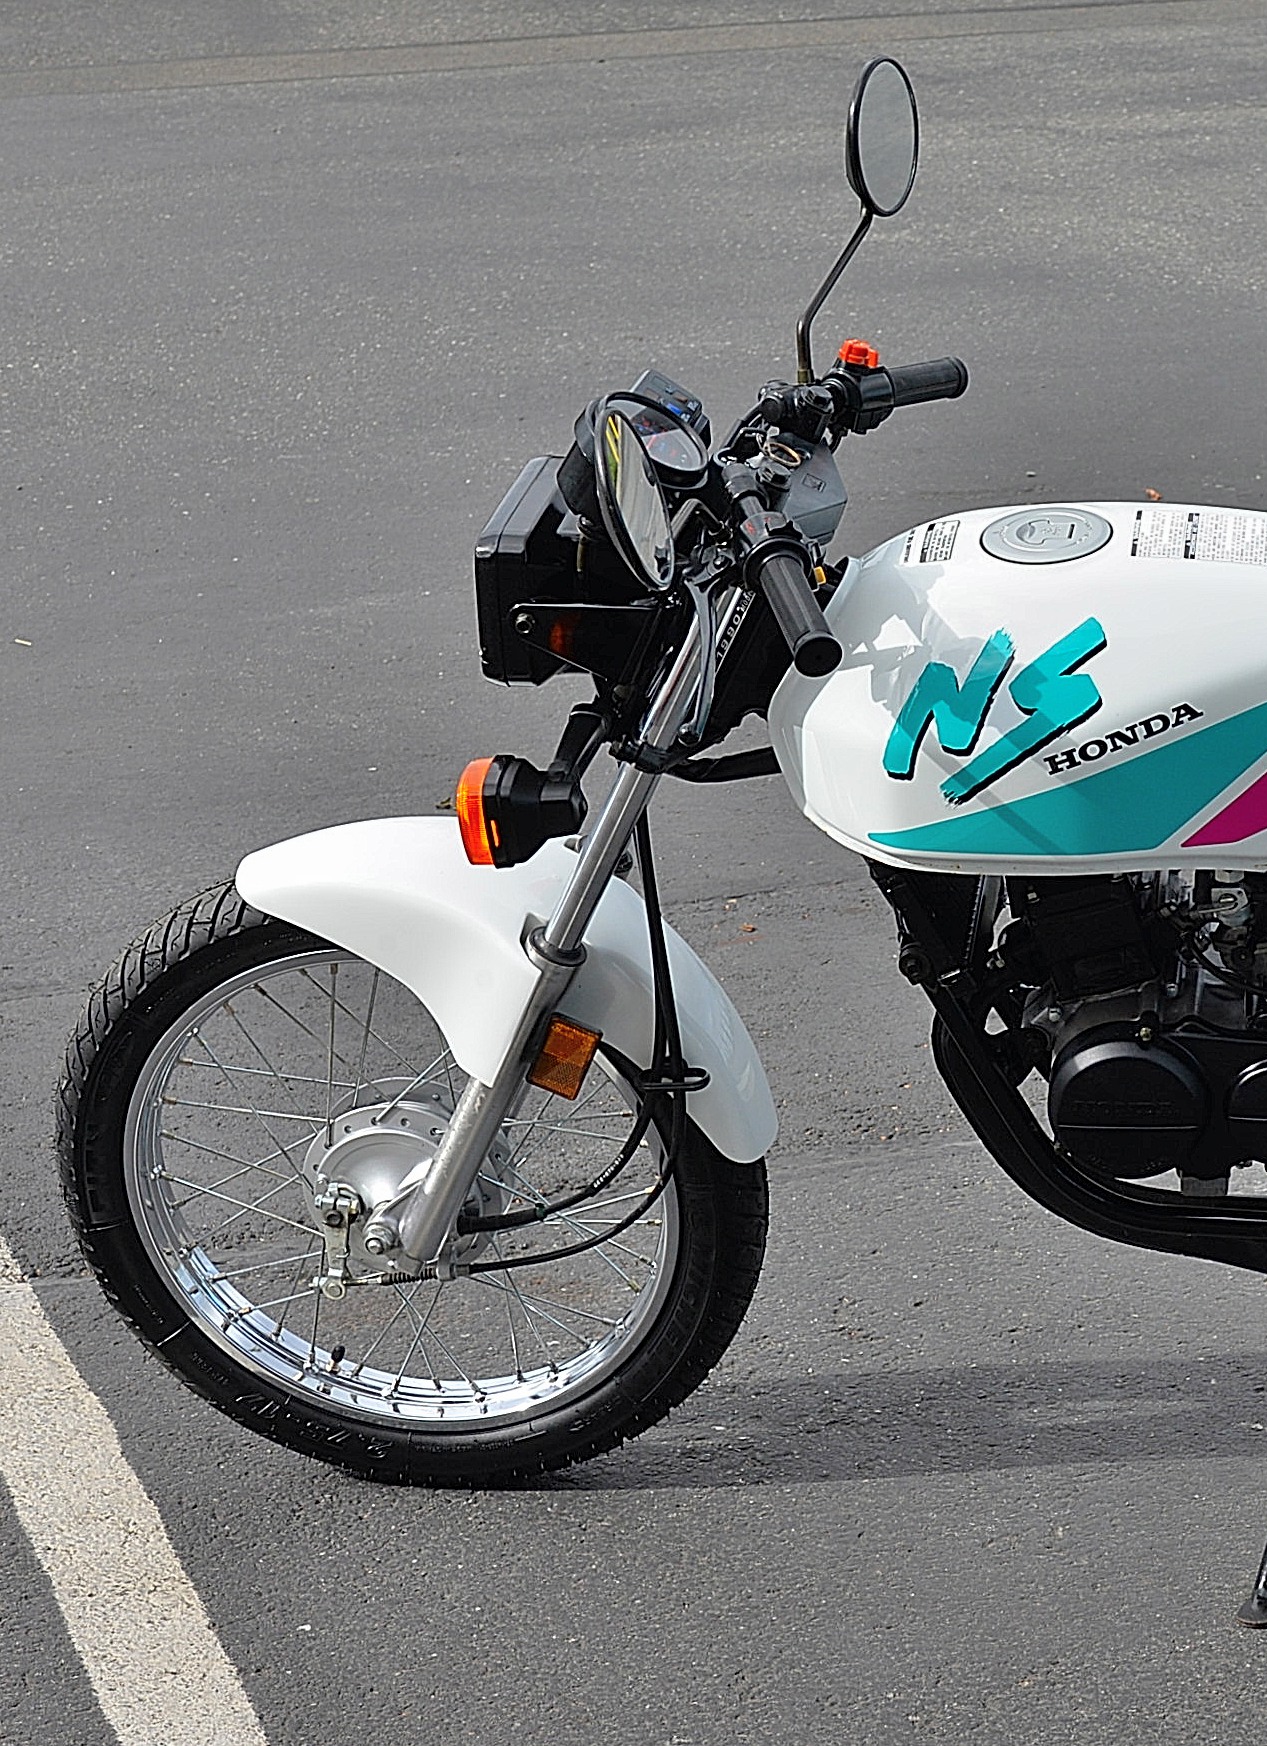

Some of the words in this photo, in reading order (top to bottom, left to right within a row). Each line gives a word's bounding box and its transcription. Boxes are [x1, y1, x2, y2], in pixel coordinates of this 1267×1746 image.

[716, 614, 741, 658] 1990
[882, 616, 1107, 807] NS
[1043, 702, 1204, 775] HONDA
